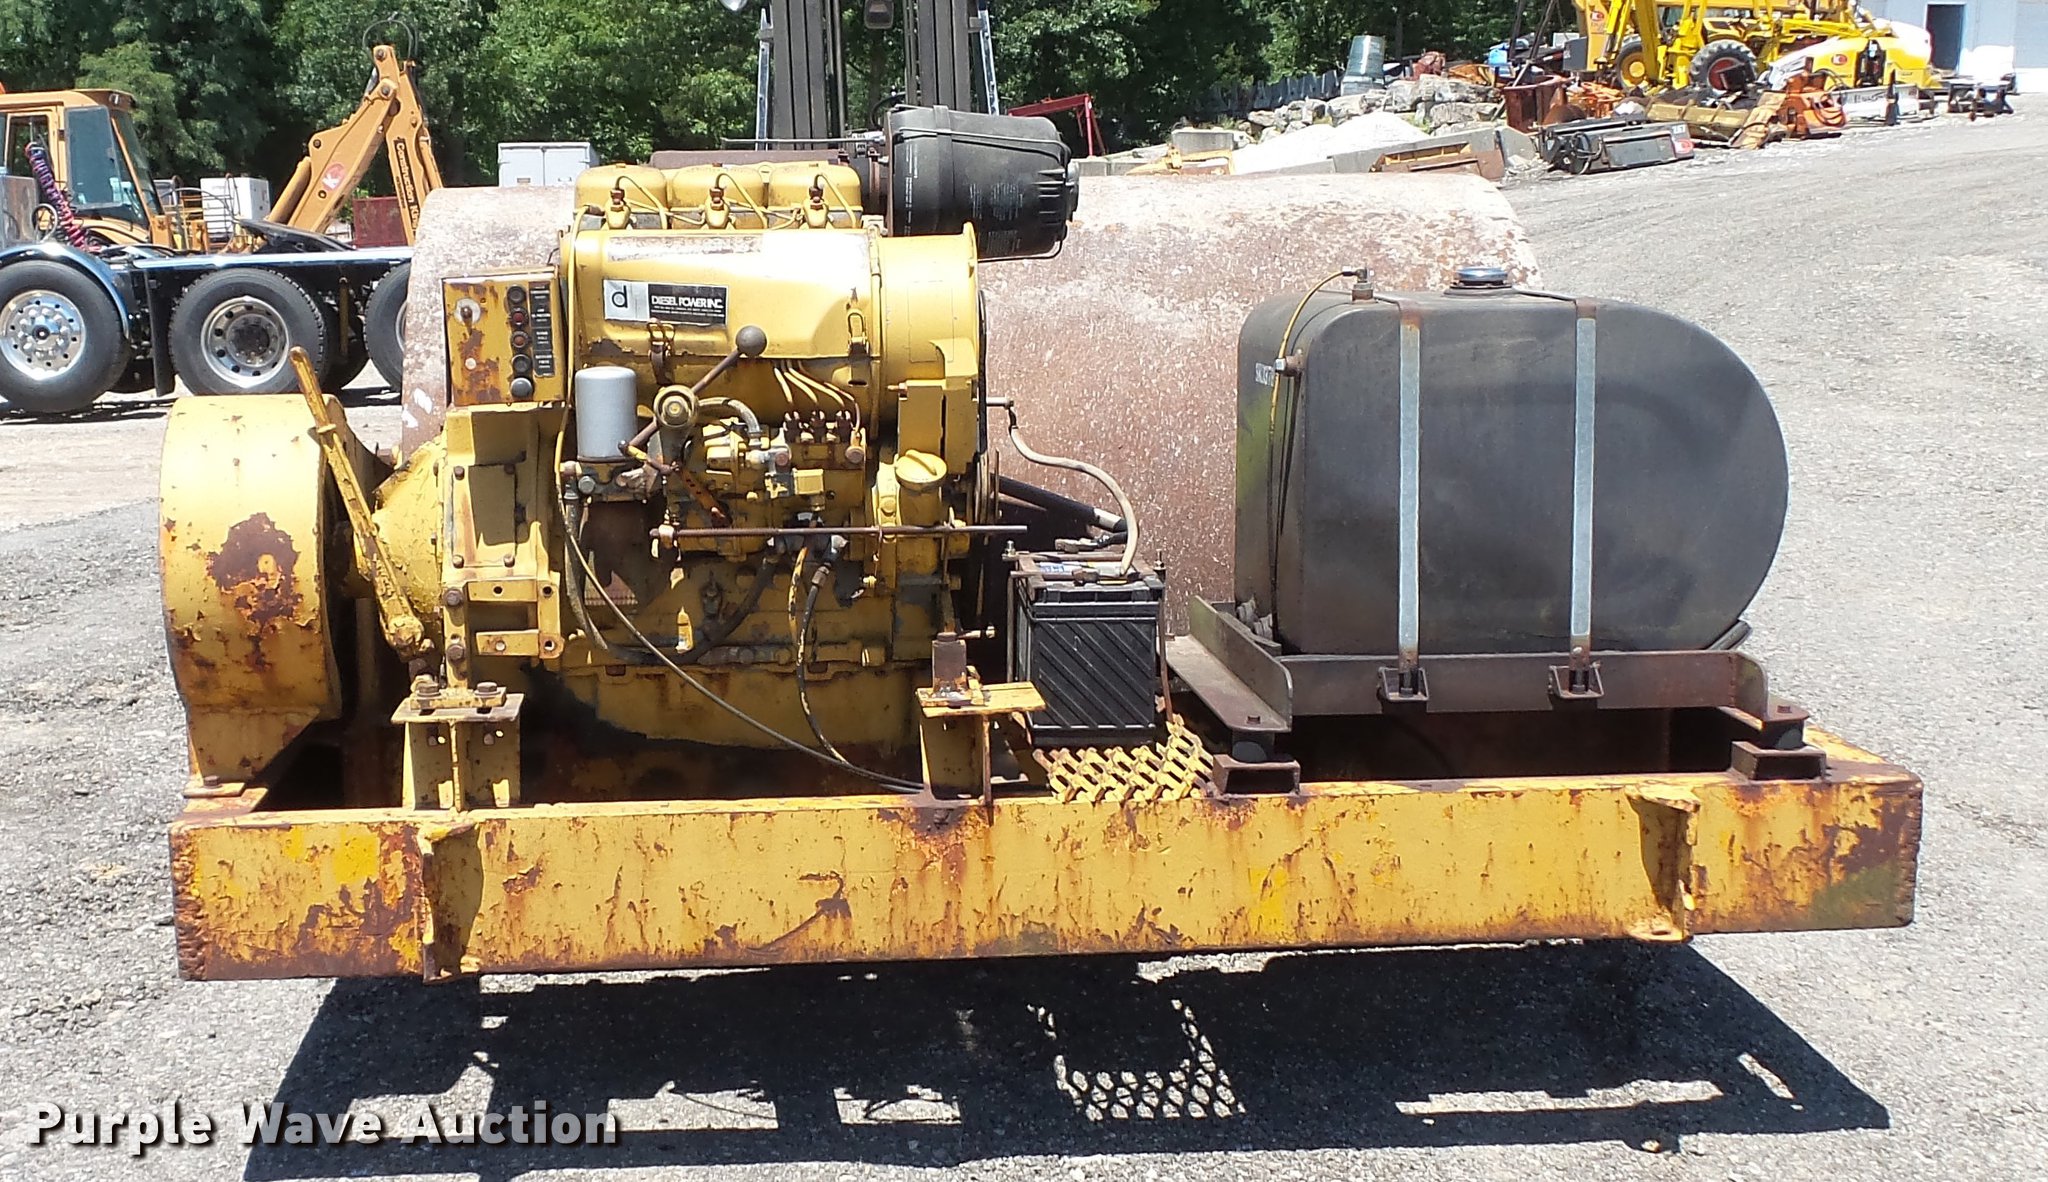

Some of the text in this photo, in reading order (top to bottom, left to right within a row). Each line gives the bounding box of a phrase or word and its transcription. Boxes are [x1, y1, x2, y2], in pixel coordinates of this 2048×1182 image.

[396, 141, 415, 203] Construction
[651, 295, 678, 306] DIESEL
[678, 296, 706, 308] POWER
